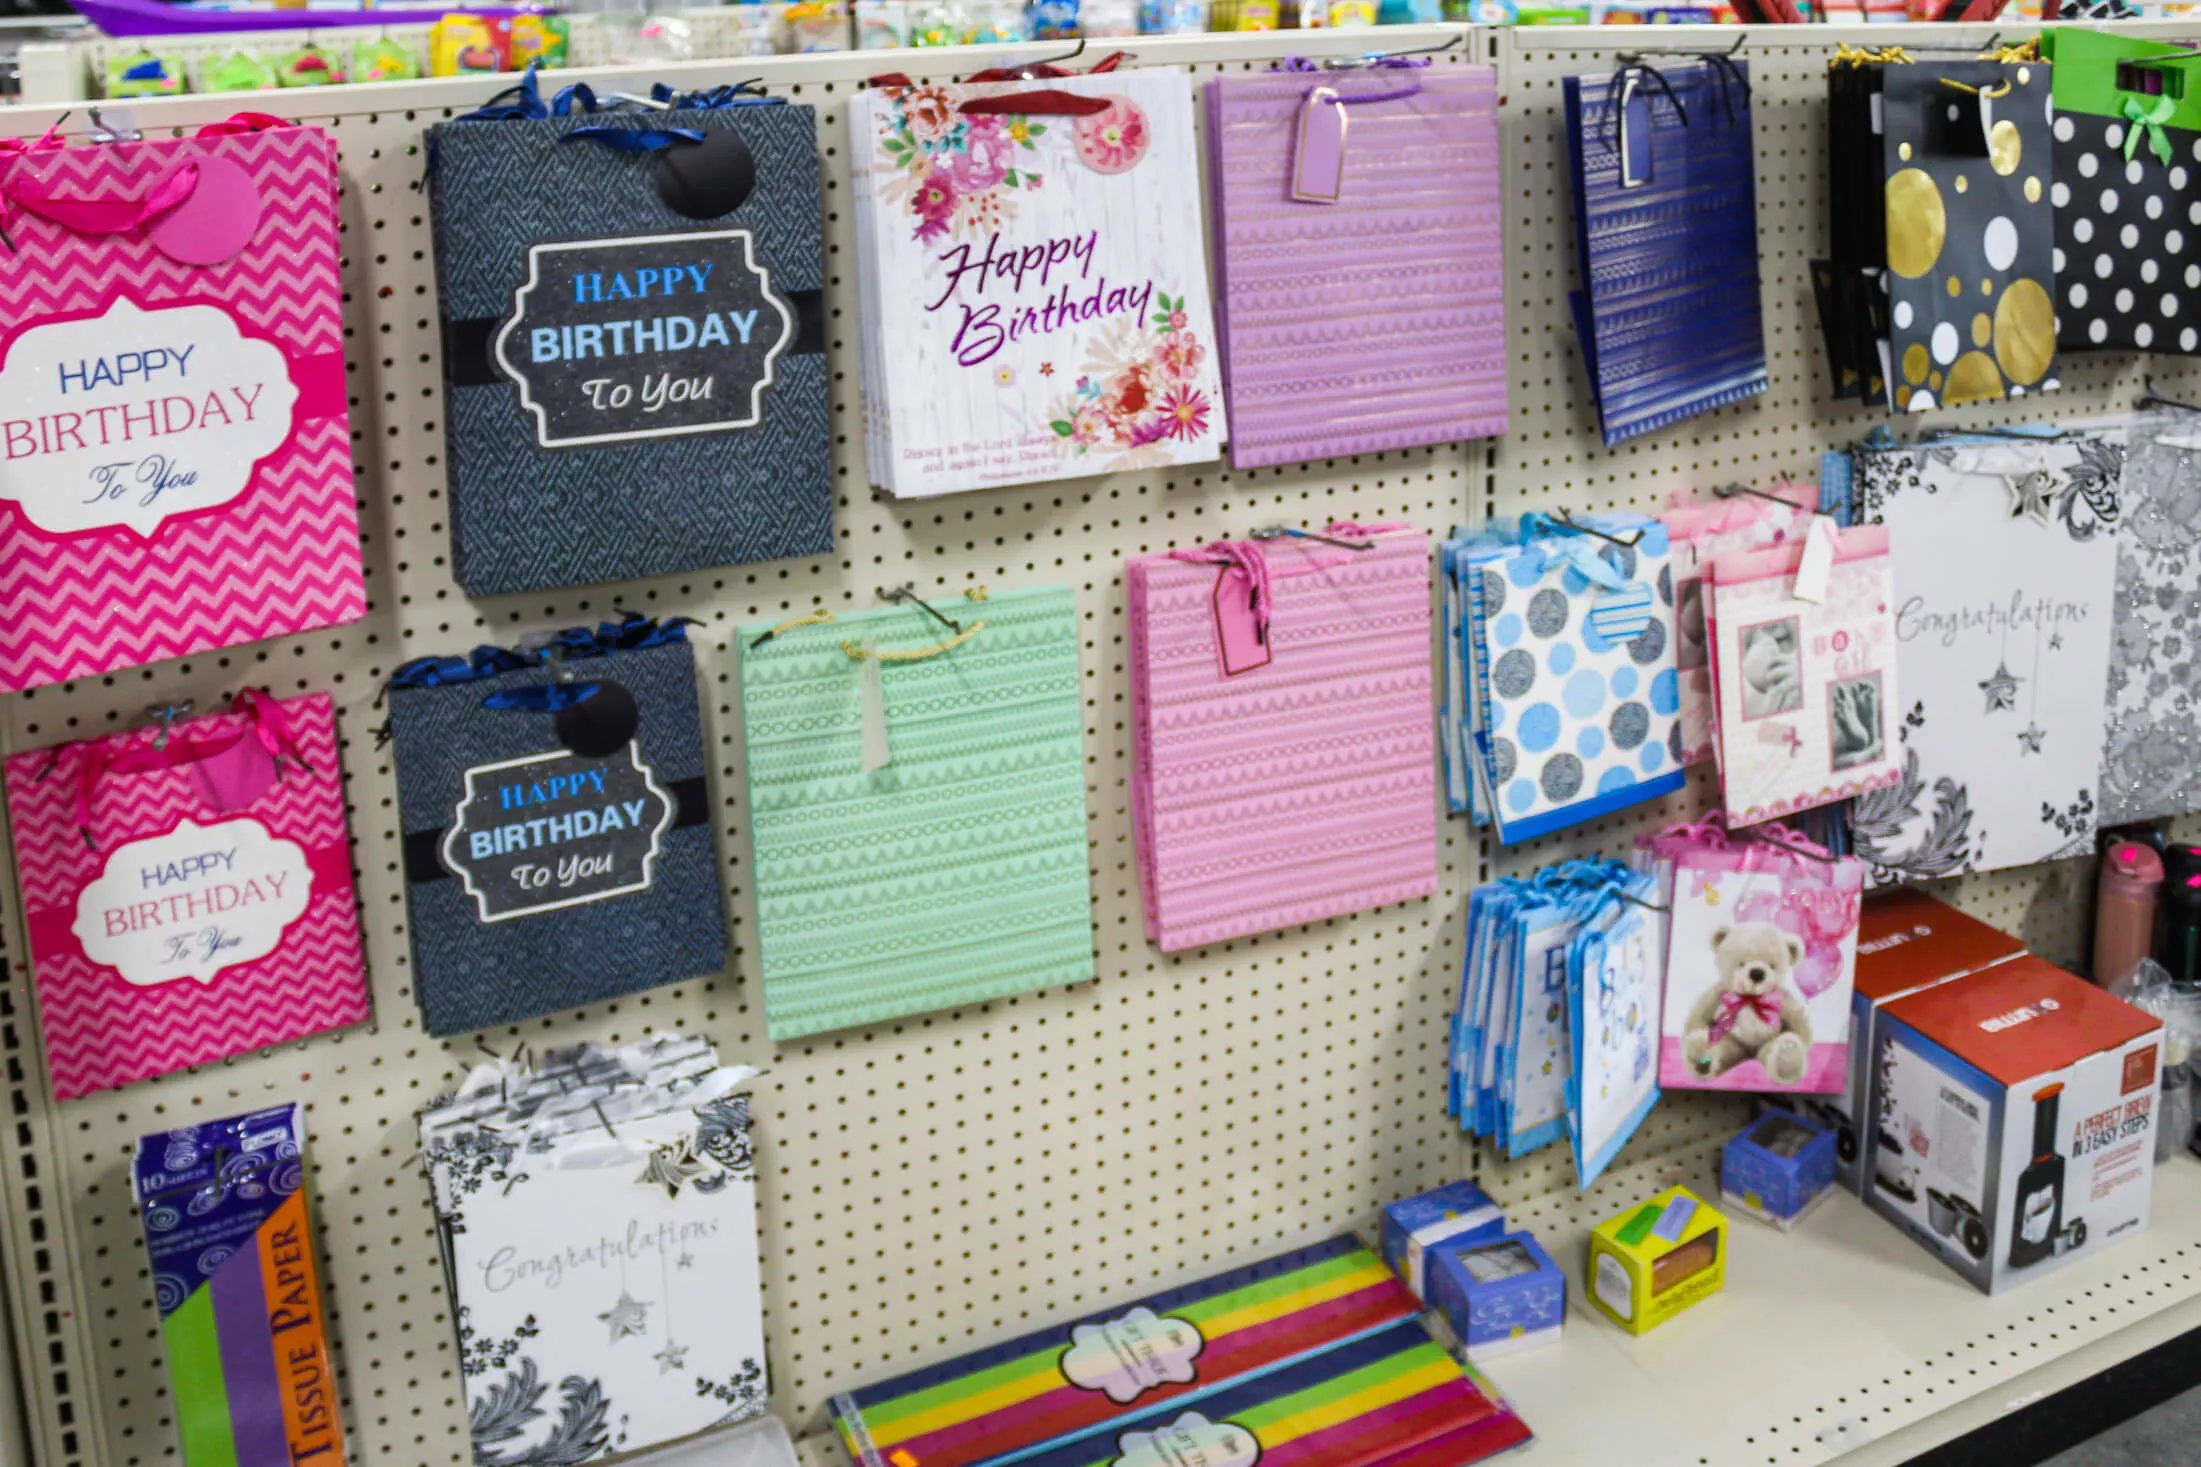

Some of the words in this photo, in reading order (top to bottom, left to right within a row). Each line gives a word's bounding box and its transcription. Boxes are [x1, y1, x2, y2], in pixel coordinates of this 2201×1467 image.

[572, 263, 715, 303] HAPPY
[924, 229, 1098, 312] Happy
[530, 309, 760, 364] BIRTHDAY
[950, 277, 1153, 367] Birthday
[58, 344, 196, 395] HAPPY
[581, 377, 633, 411] To
[641, 372, 715, 413] You
[1, 384, 265, 461] BIRTHDAY
[82, 460, 136, 504] To
[135, 454, 199, 507] You
[1894, 588, 2089, 648] Congratulations
[500, 767, 609, 811] HAPPY
[469, 799, 646, 860] BIRTHDAY
[140, 846, 238, 890] HAPPY
[510, 863, 552, 890] To
[557, 853, 614, 887] You
[103, 871, 289, 939] BIRTHDAY
[159, 931, 198, 965] To
[199, 925, 244, 963] You
[142, 1173, 166, 1194] 10
[270, 1219, 313, 1336] PAPER
[477, 1218, 720, 1294] Congratulations
[288, 1343, 334, 1467] TISSUE
